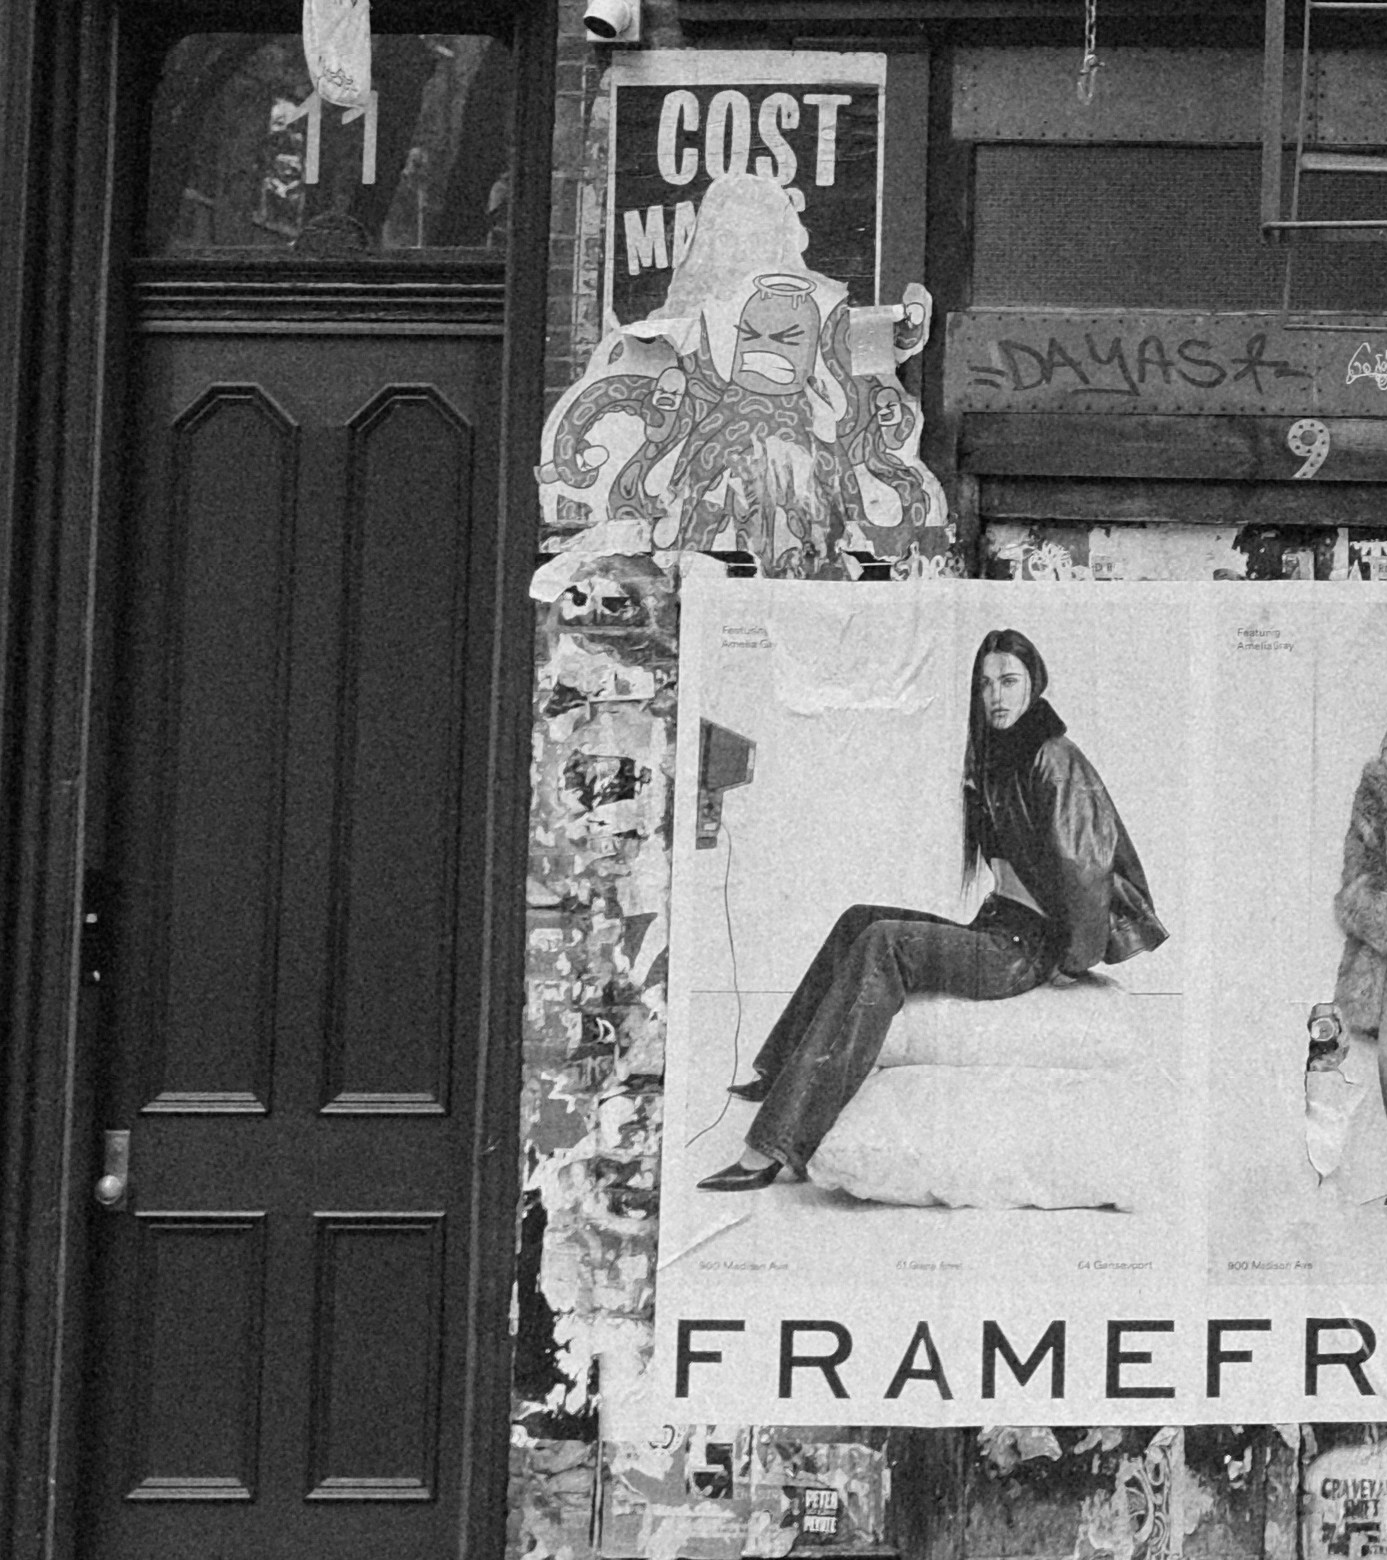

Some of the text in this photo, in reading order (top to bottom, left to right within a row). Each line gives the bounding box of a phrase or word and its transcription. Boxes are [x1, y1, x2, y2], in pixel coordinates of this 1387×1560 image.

[657, 89, 852, 186] COST
[1287, 418, 1331, 479] 9
[675, 1319, 1175, 1399] FRAME
